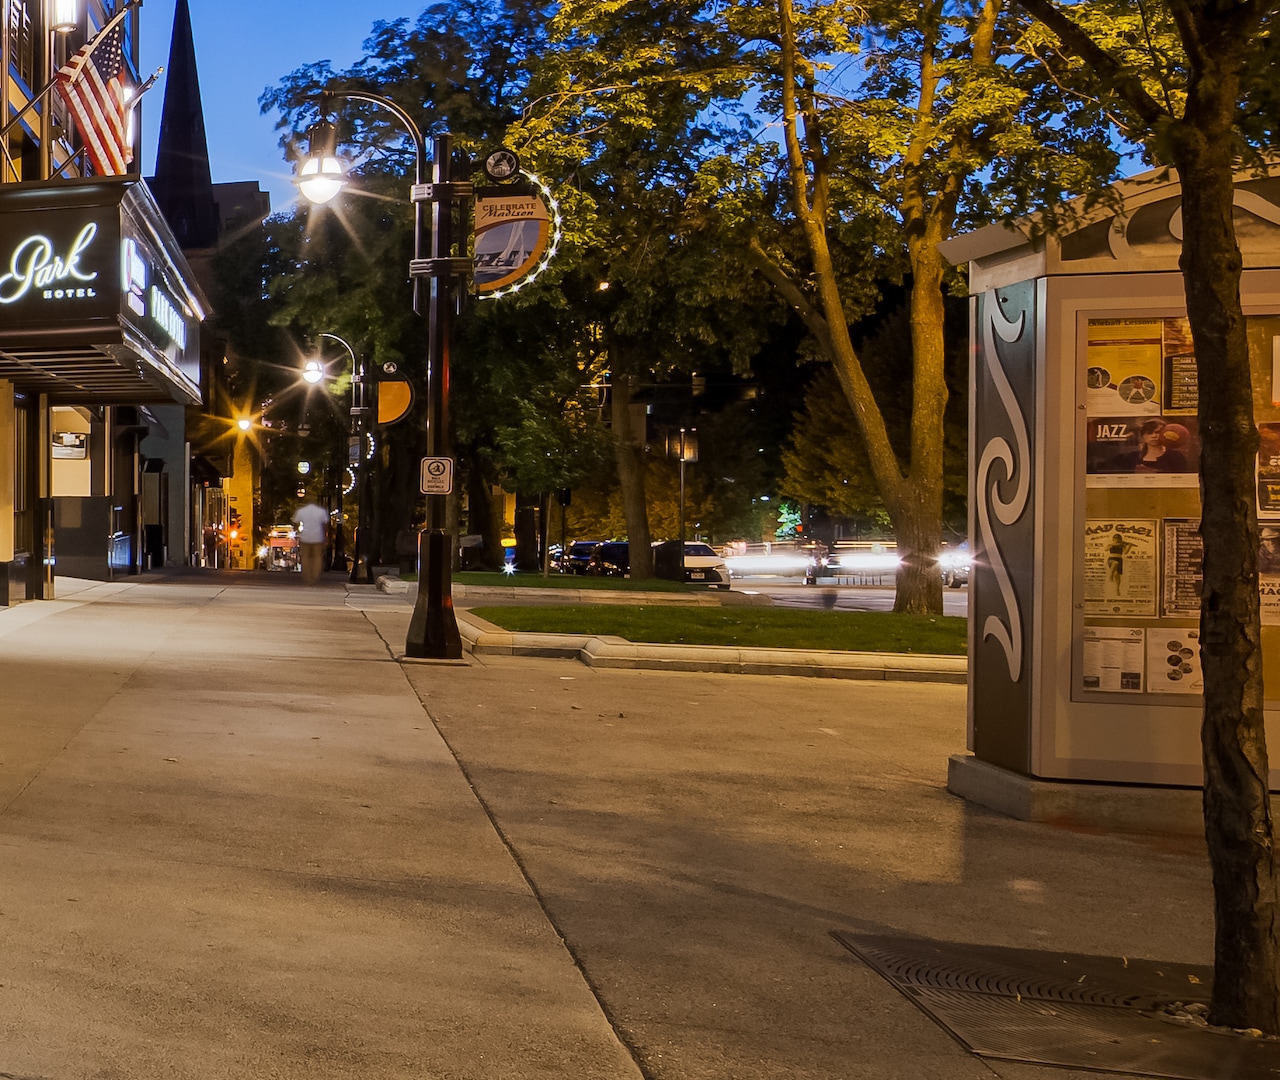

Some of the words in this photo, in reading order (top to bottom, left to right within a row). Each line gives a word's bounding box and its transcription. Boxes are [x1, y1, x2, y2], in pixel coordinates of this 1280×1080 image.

[482, 202, 537, 212] CELEBRATE
[481, 209, 534, 220] Madison
[42, 287, 97, 300] HOTEL
[1096, 424, 1128, 438] JAZZ
